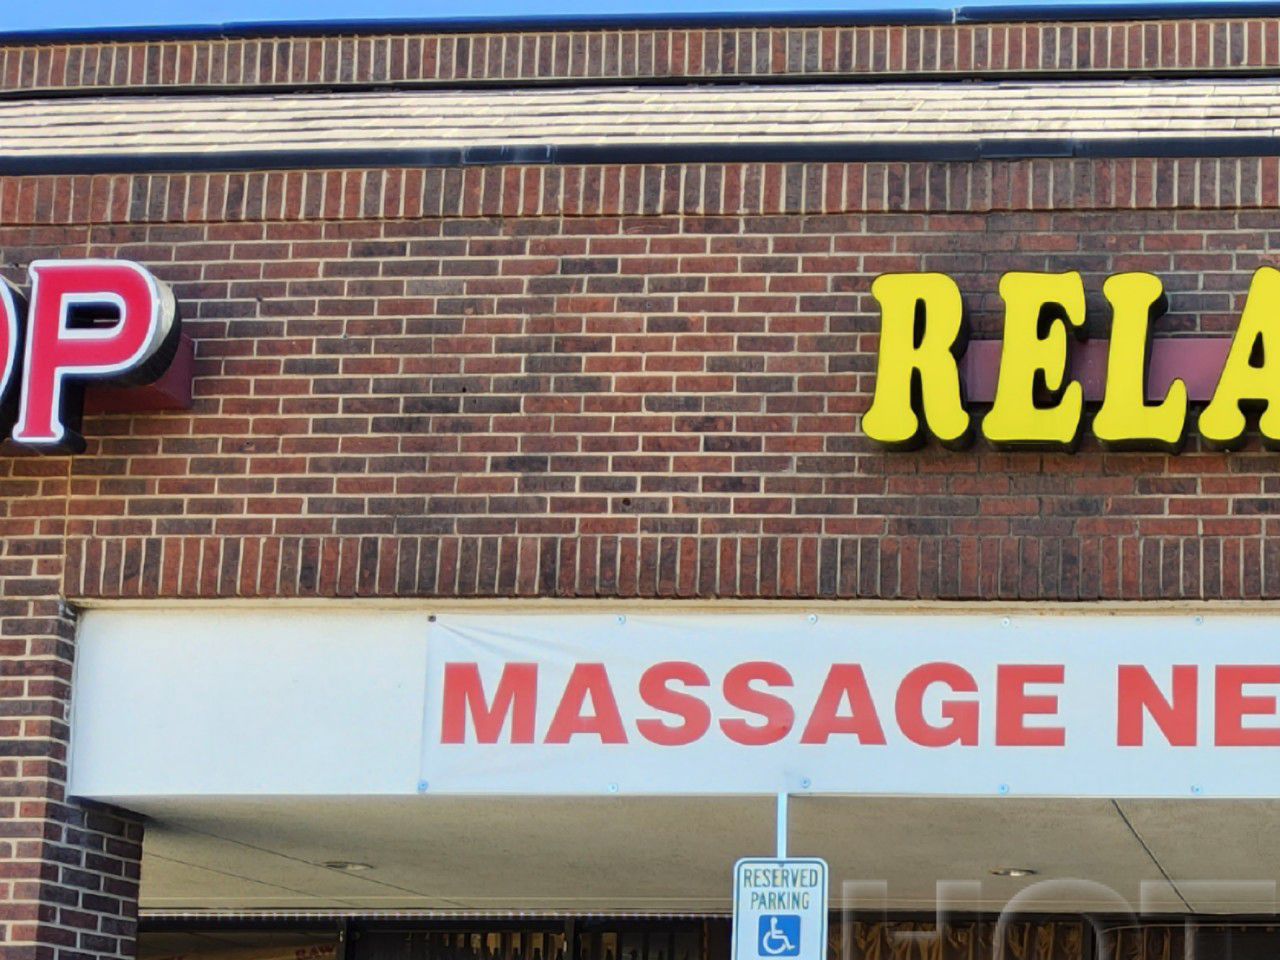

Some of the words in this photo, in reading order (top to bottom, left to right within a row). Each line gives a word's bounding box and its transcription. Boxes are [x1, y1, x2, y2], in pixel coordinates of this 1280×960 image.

[440, 661, 1066, 747] MASSAGE
[743, 868, 819, 888] RESERVED
[750, 891, 810, 910] PARKING
